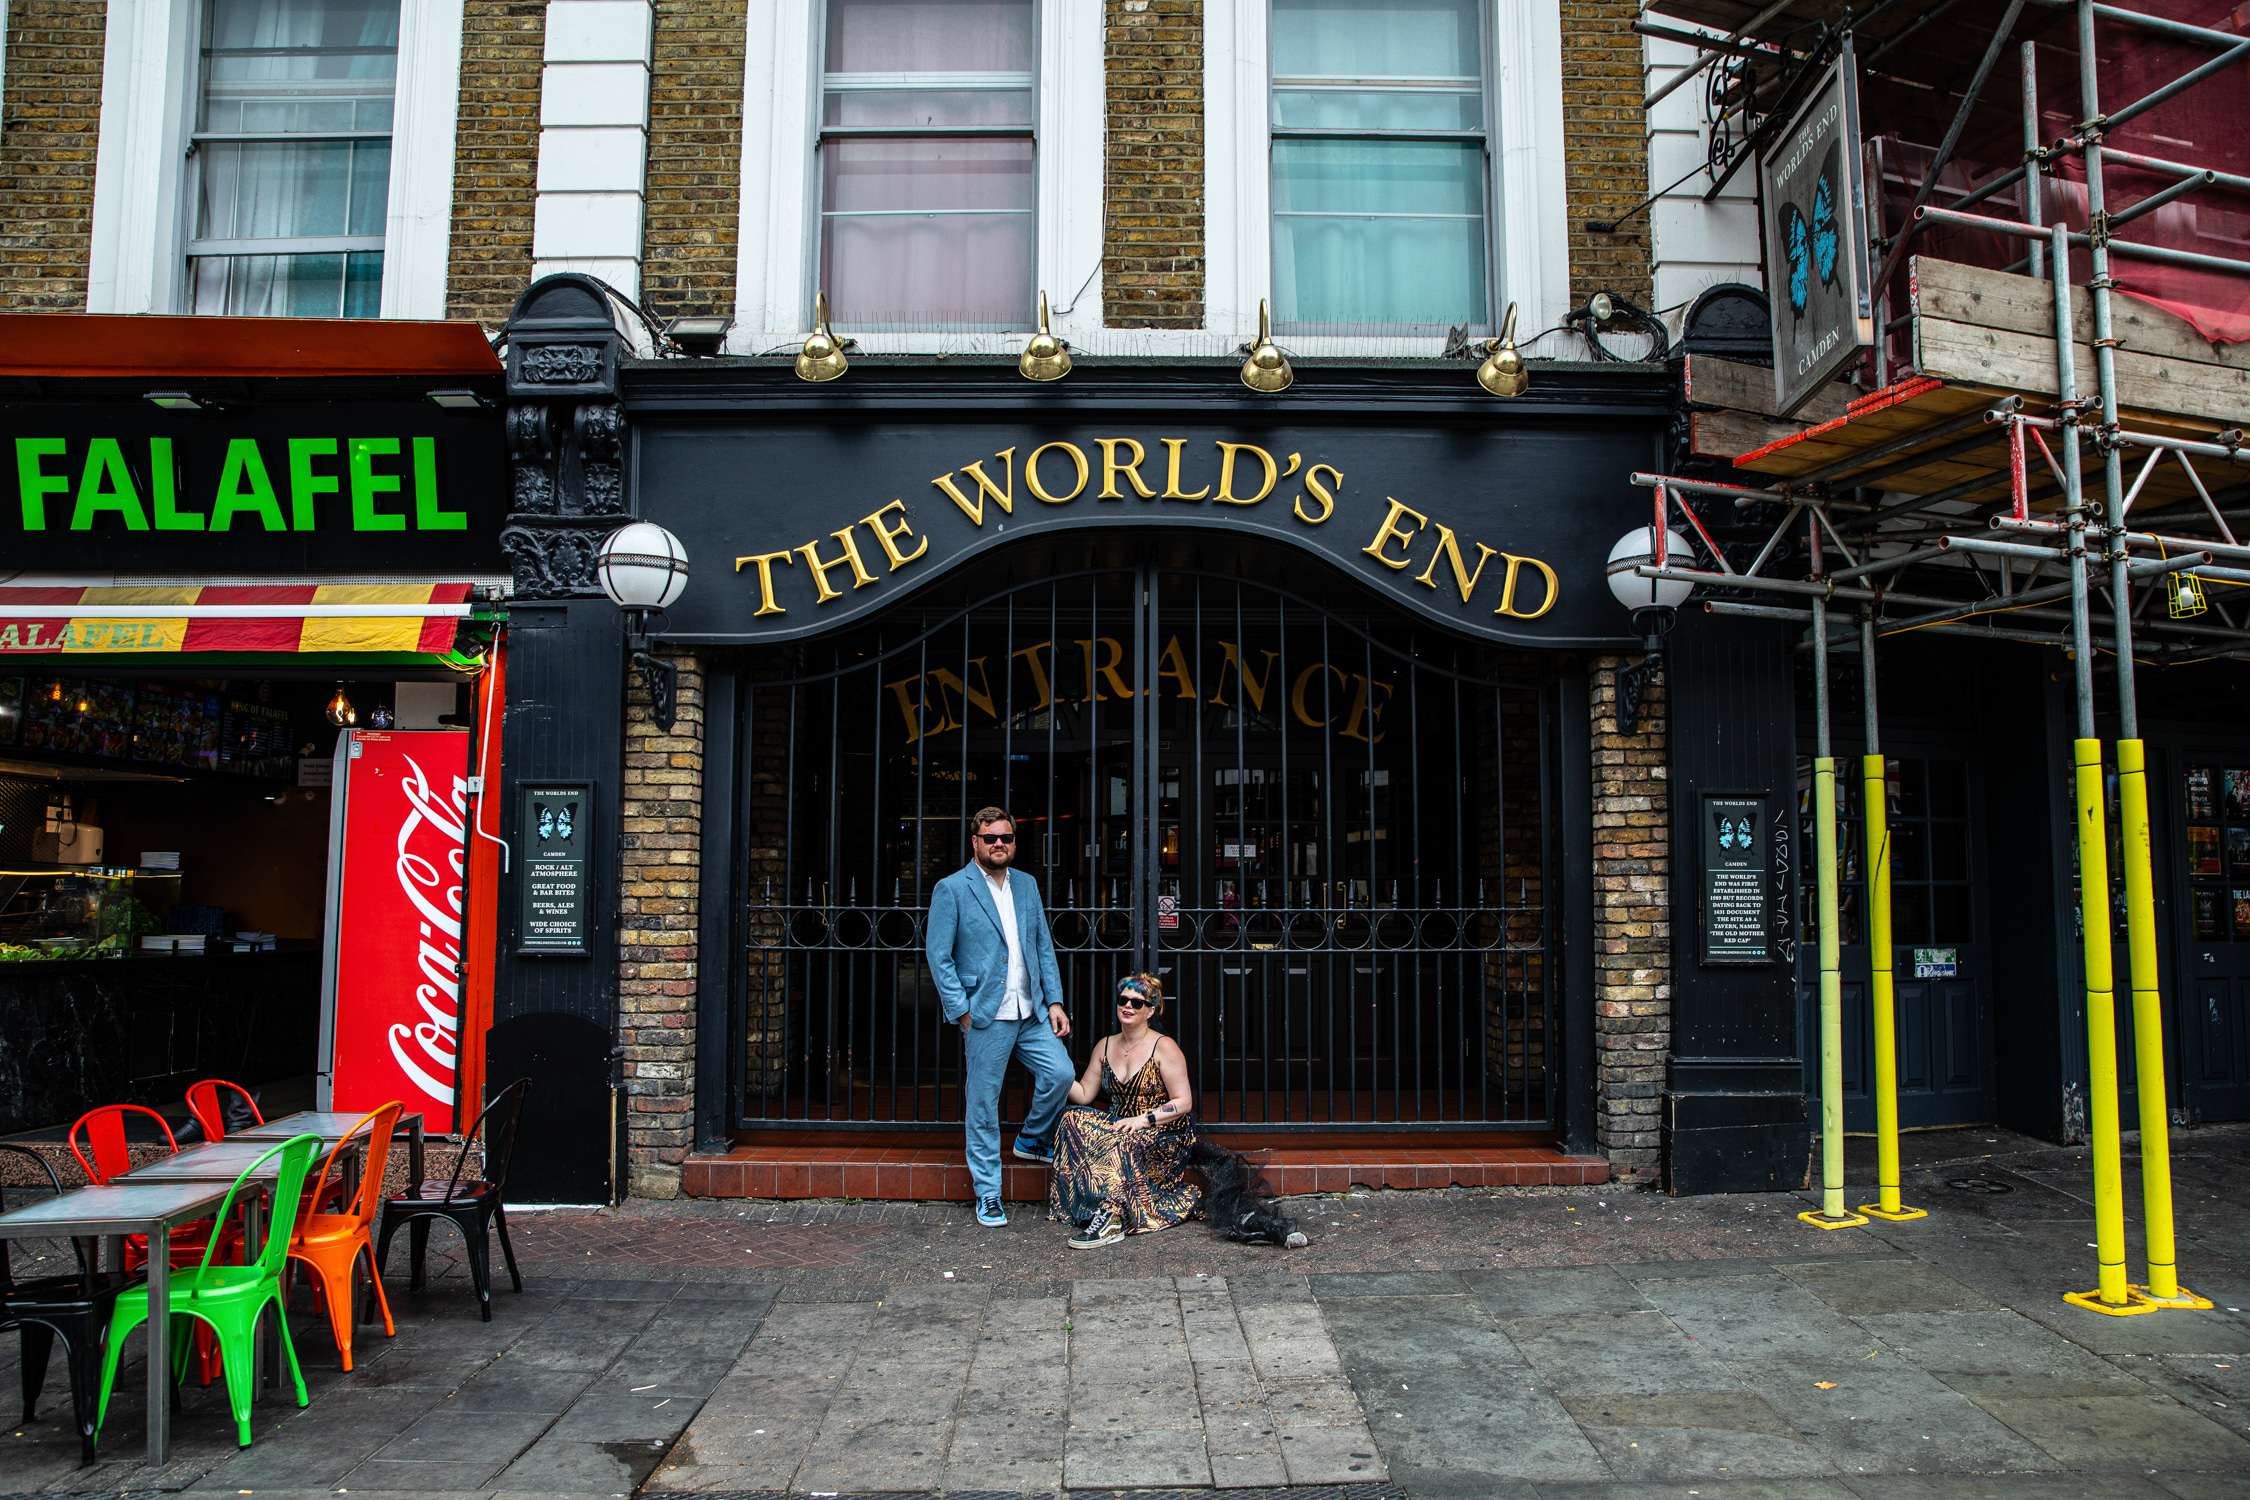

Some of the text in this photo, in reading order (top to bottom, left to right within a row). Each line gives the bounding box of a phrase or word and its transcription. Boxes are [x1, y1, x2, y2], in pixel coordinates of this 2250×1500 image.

[1776, 104, 1838, 189] WORLDS END
[1798, 122, 1811, 144] THE
[1798, 326, 1841, 376] CAMDEN
[15, 437, 468, 532] FALAFEL
[735, 437, 1560, 620] THE WORLD'S END
[884, 634, 1393, 744] ENTRANCE
